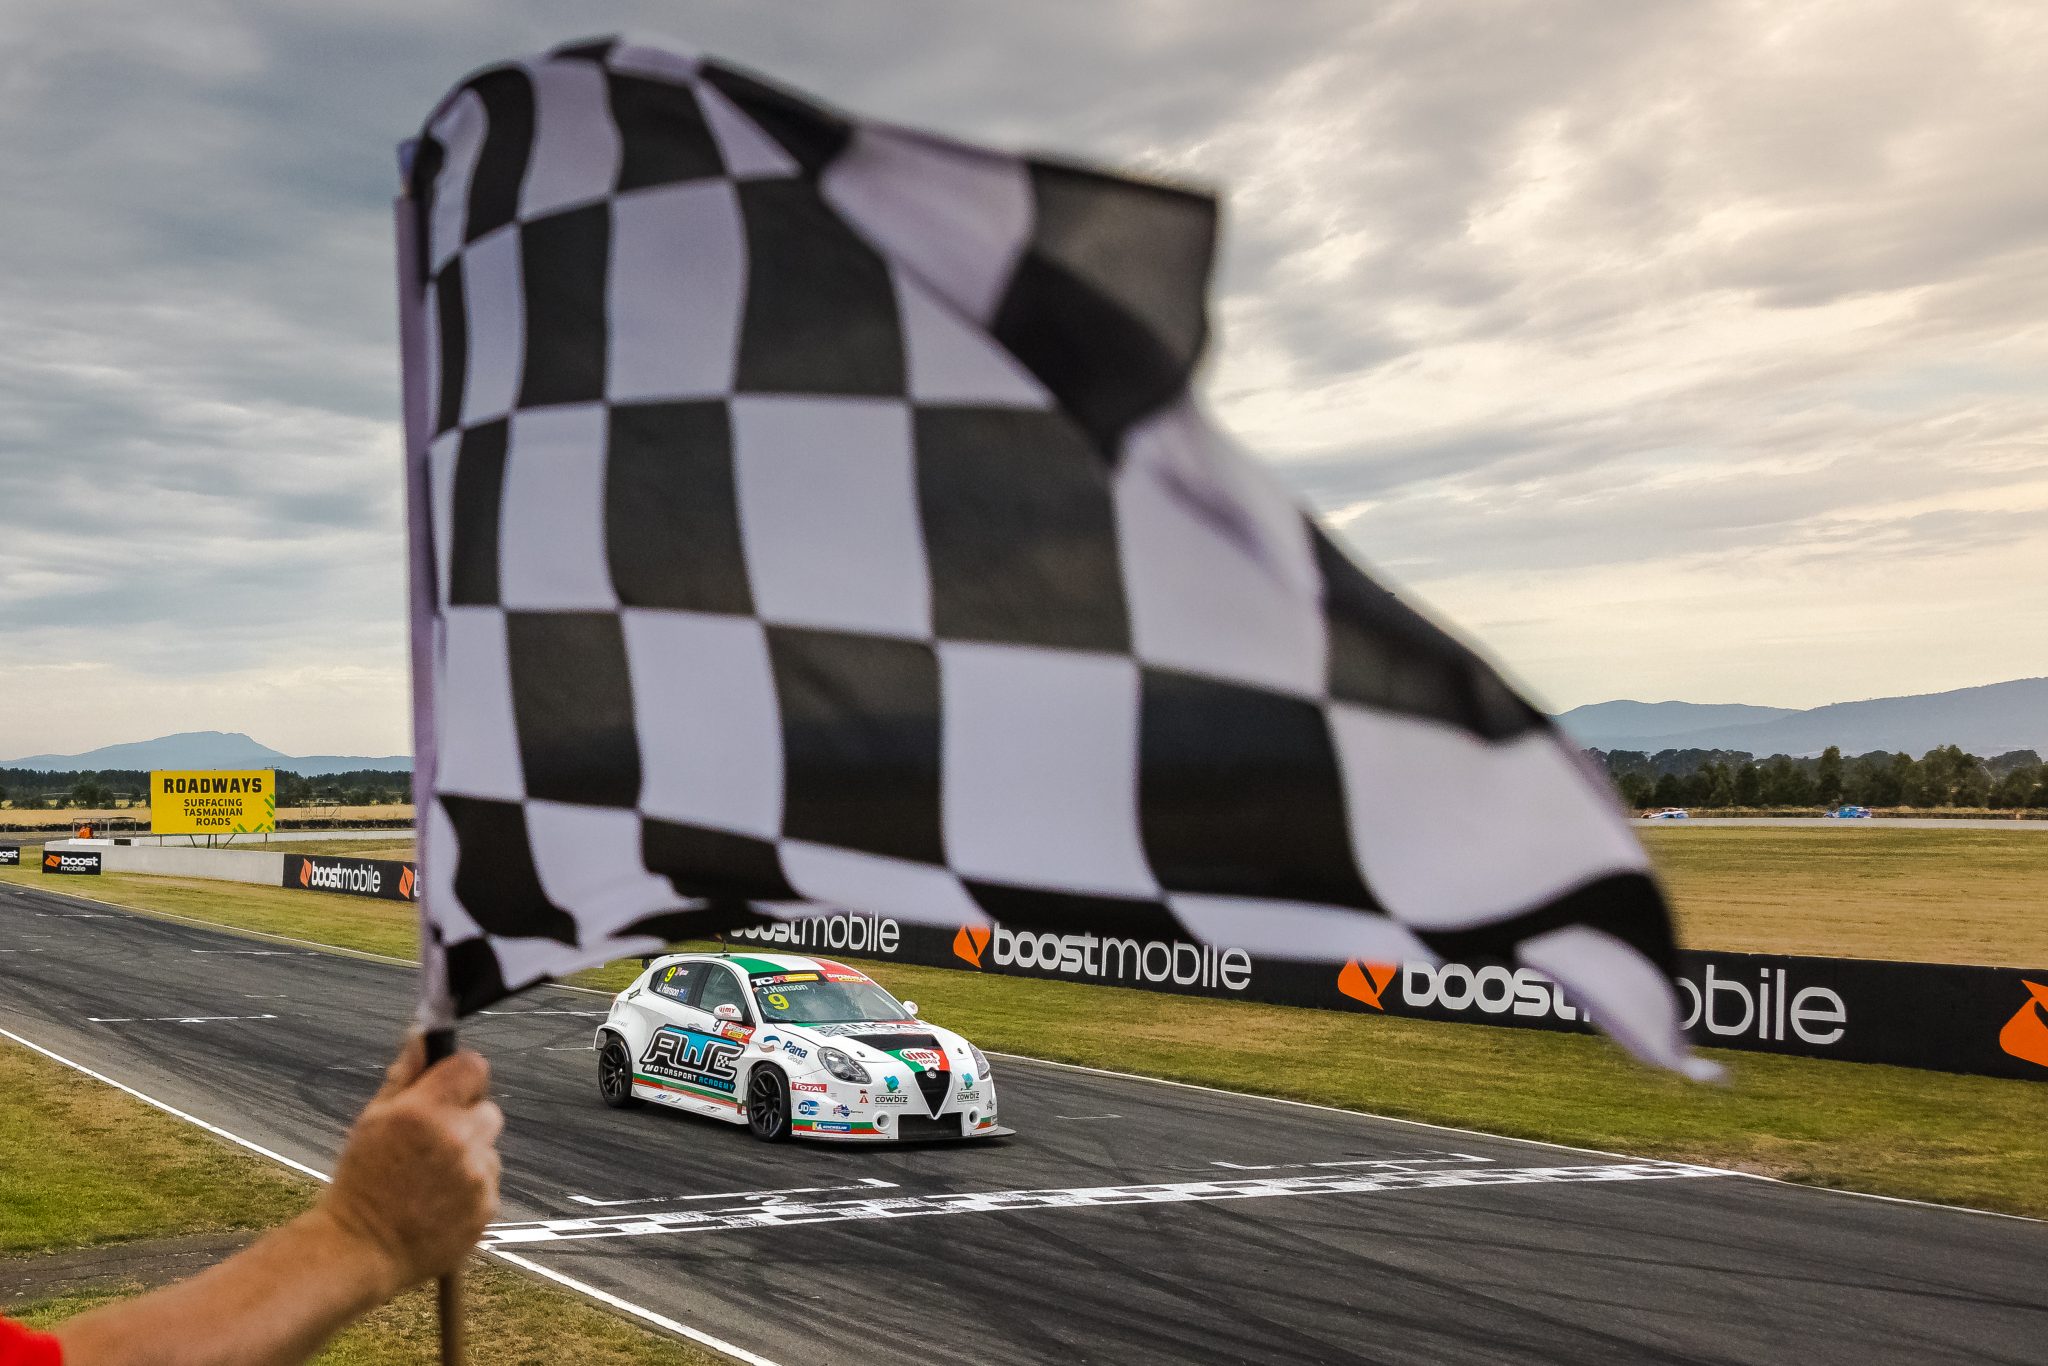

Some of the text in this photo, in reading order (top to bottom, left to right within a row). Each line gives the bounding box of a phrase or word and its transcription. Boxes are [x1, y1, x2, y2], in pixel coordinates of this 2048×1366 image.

[163, 778, 262, 794] ROADWAYS
[183, 798, 243, 807] SURFACING
[184, 808, 243, 817] TASMANIAN
[196, 817, 231, 826] ROADS
[0, 850, 19, 859] ost
[61, 855, 99, 867] boost
[664, 966, 677, 983] 9
[751, 975, 788, 986] TCR
[768, 993, 790, 1010] 9
[713, 1020, 722, 1032] 9
[783, 1040, 809, 1059] Pana
[788, 1055, 804, 1066] Group
[644, 1064, 736, 1092] MOTORSPORT ACADEMY
[794, 1083, 825, 1092] TOTAL
[874, 1095, 908, 1103] cowbiz
[956, 1092, 980, 1101] cowbiz
